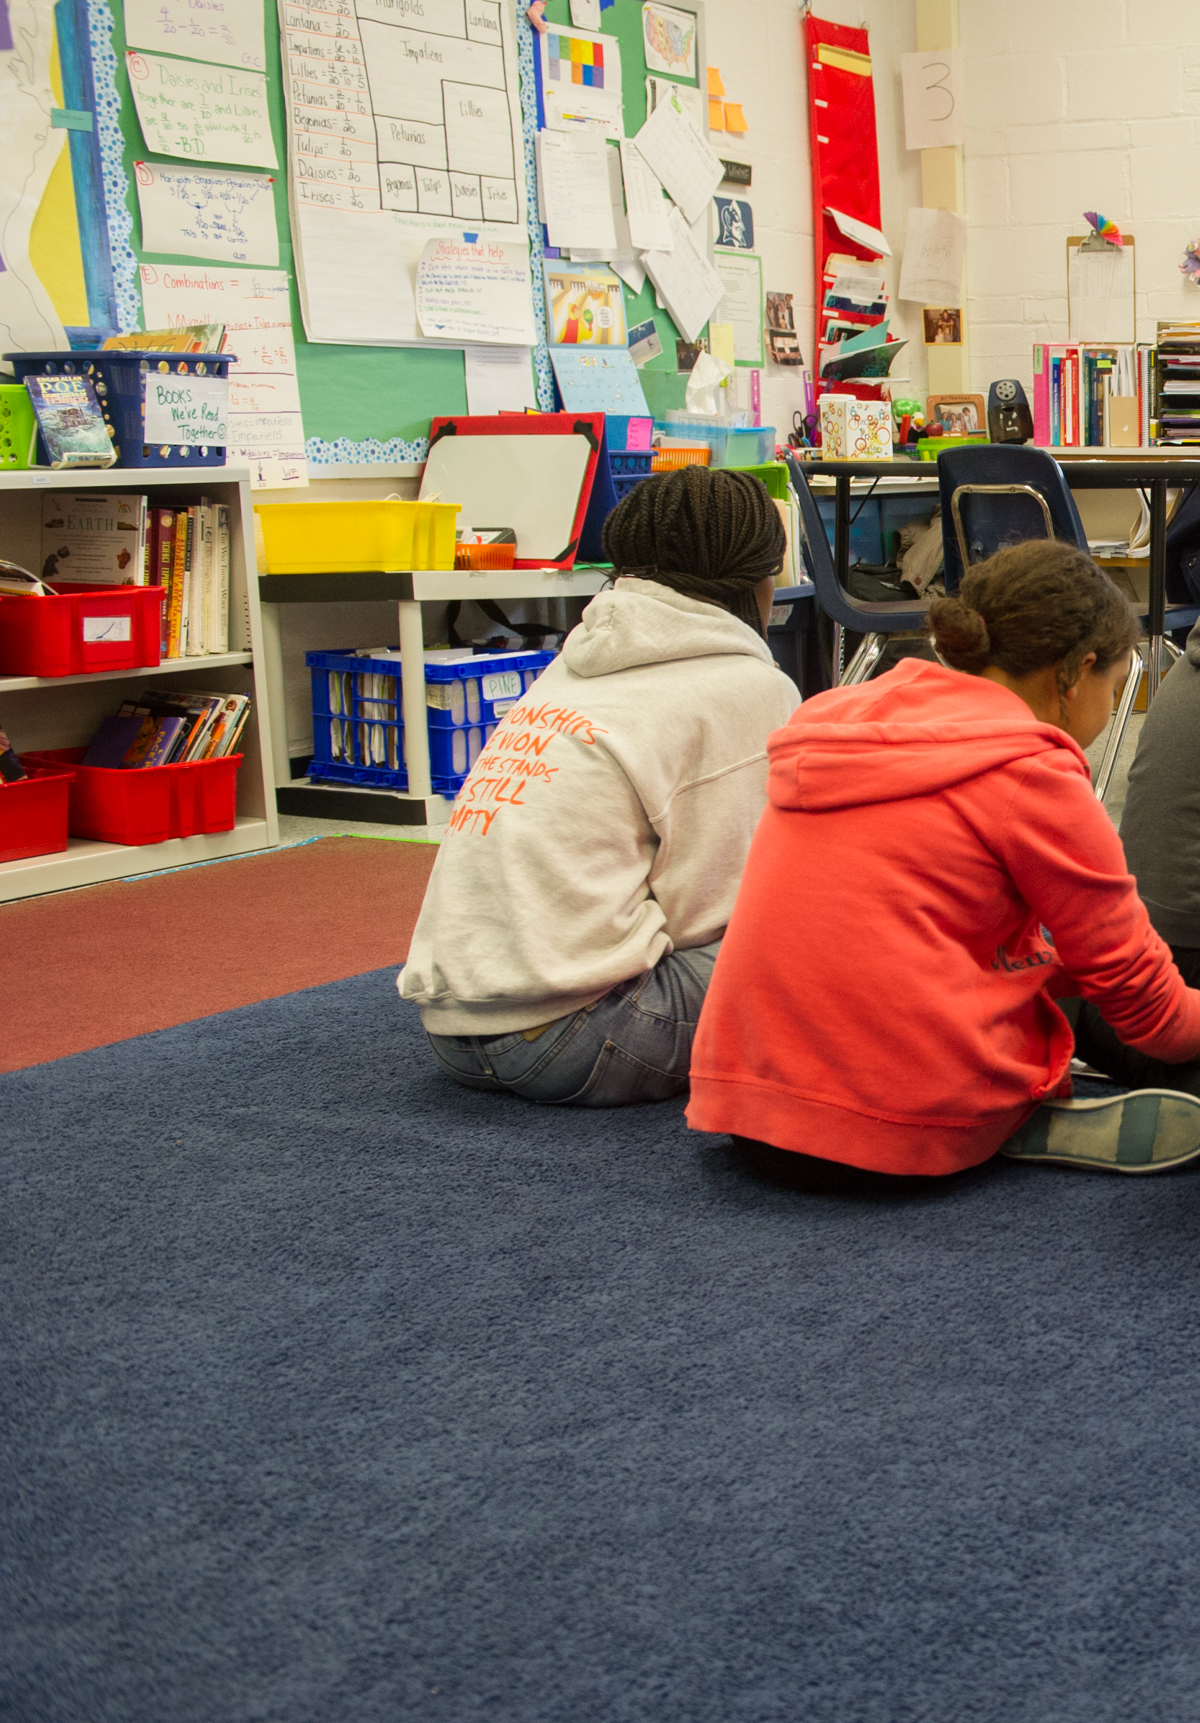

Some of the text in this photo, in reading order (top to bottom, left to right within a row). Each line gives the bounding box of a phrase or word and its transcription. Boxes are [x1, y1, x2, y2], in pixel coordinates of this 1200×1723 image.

[285, 7, 322, 32] Lantana
[469, 10, 499, 32] Lantana
[400, 40, 443, 64] Impatiens
[156, 64, 262, 98] Daisies and Irises
[922, 63, 954, 121] 3
[460, 100, 484, 117] Lillies
[390, 123, 426, 144] Petunias
[294, 133, 324, 158] Tulips
[298, 159, 337, 180] Daisies
[299, 181, 335, 205] Irises
[435, 240, 504, 261] Strategies that help
[163, 273, 225, 291] Combinations
[38, 381, 86, 393] POE
[171, 402, 219, 421] We've Read
[67, 514, 114, 531] EARTH
[489, 675, 518, 698] PINE
[497, 757, 560, 783] STANDS
[466, 777, 526, 805] STILL
[444, 804, 503, 837] MPTY
